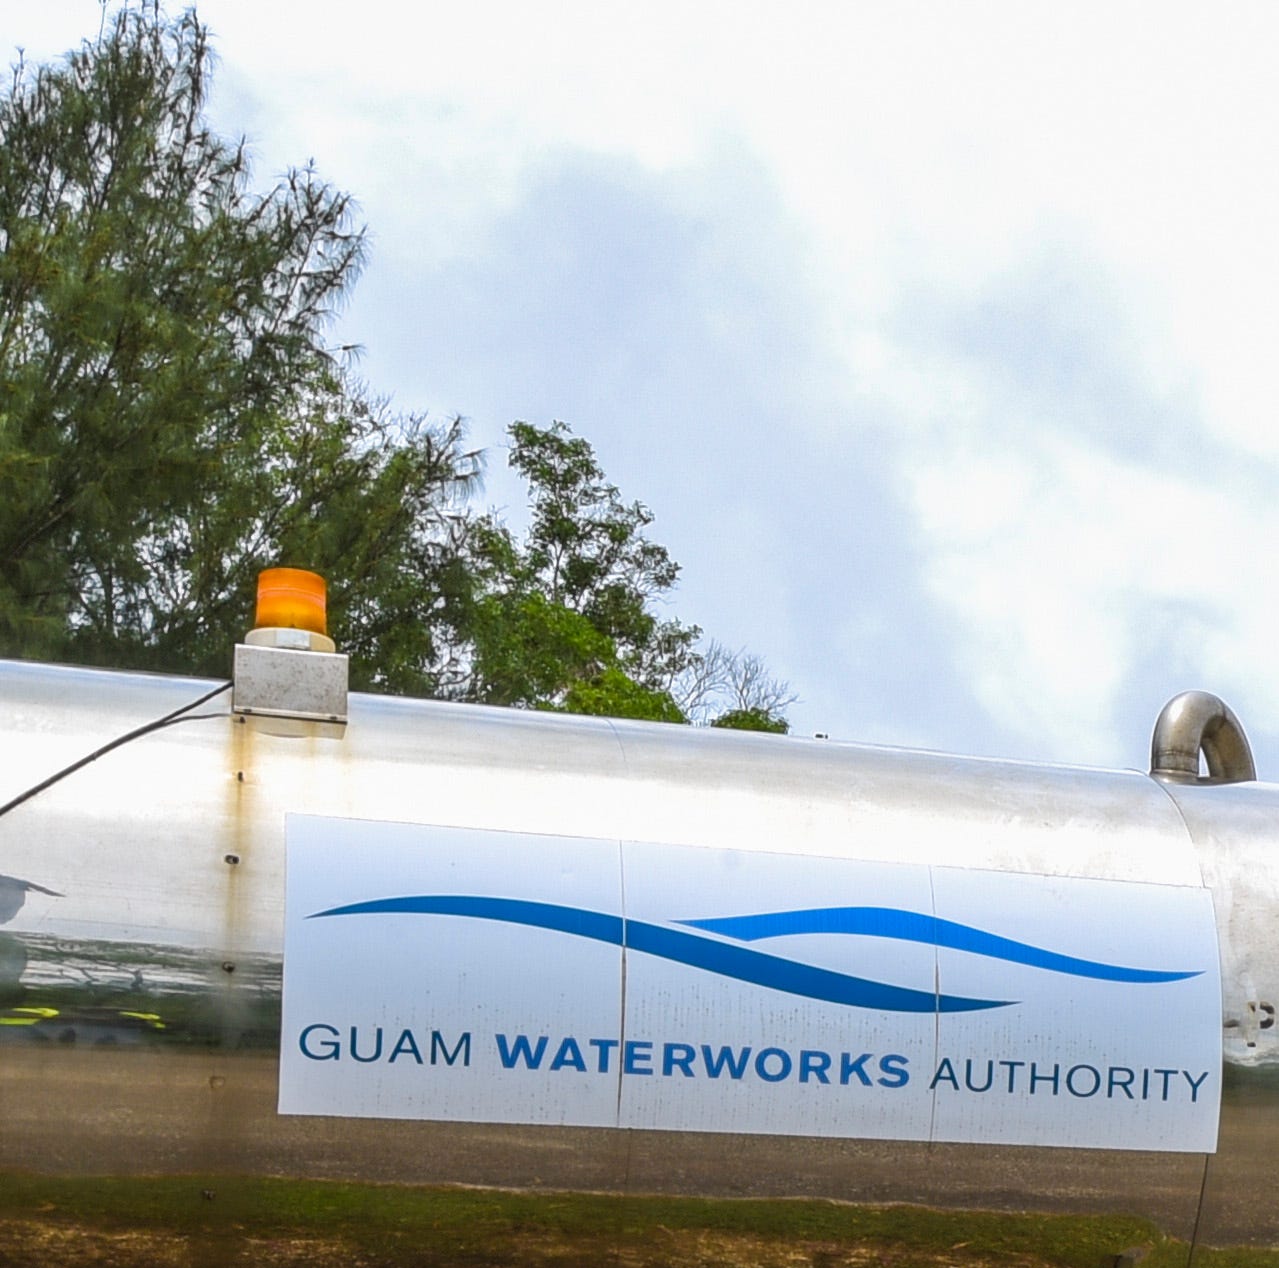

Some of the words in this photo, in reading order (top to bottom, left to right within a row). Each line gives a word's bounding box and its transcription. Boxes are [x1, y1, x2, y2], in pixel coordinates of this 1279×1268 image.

[298, 1022, 473, 1068] GUAM
[494, 1032, 911, 1090] WATERWORKS
[928, 1057, 1210, 1104] AUTHORITY
